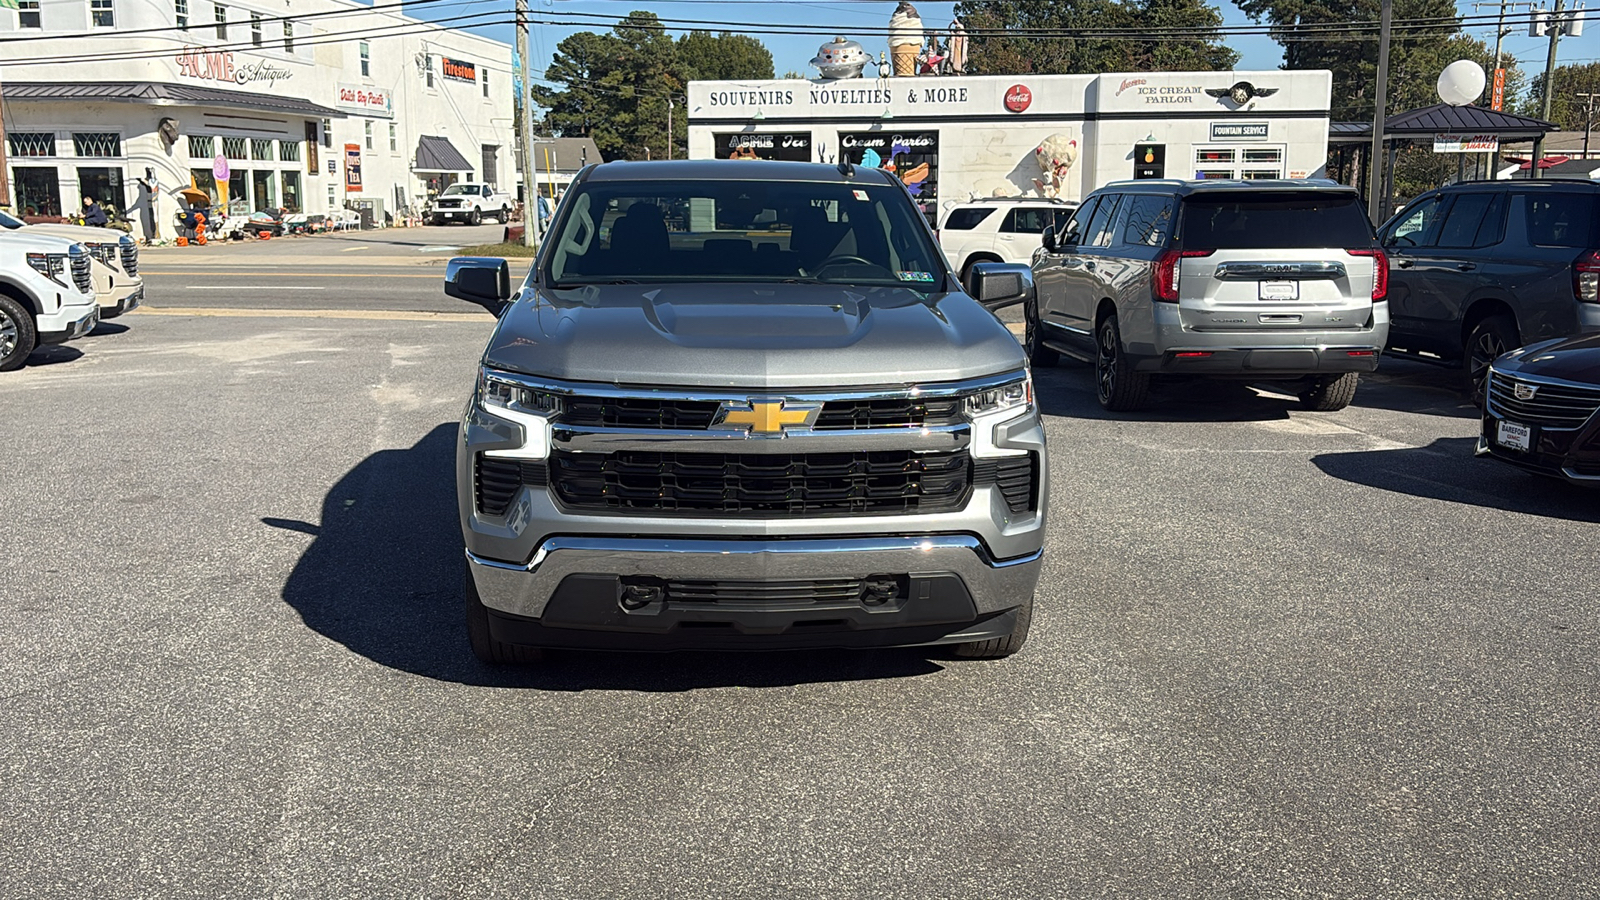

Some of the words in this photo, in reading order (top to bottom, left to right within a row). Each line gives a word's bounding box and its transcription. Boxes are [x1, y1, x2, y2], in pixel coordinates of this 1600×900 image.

[176, 46, 235, 82] ACME
[442, 57, 476, 80] Firestone
[1138, 86, 1157, 95] ICE
[1159, 86, 1202, 95] CREAM
[710, 90, 793, 106] SOUVENIRS
[810, 89, 892, 105] NOVELTIES
[907, 88, 918, 103] &
[925, 87, 968, 103] MORE
[1145, 95, 1192, 104] PARLOR
[1214, 126, 1242, 135] FOUNTAIN
[1243, 126, 1266, 135] SERVICE
[729, 135, 774, 148] ACME
[782, 135, 808, 147] Ice
[842, 135, 885, 148] Cream
[891, 134, 935, 148] Parlor
[1472, 134, 1498, 143] MILK
[1465, 142, 1496, 150] SHAKES
[349, 171, 360, 183] TEA
[1501, 424, 1528, 437] BAREFORD
[1507, 433, 1520, 441] GMC
